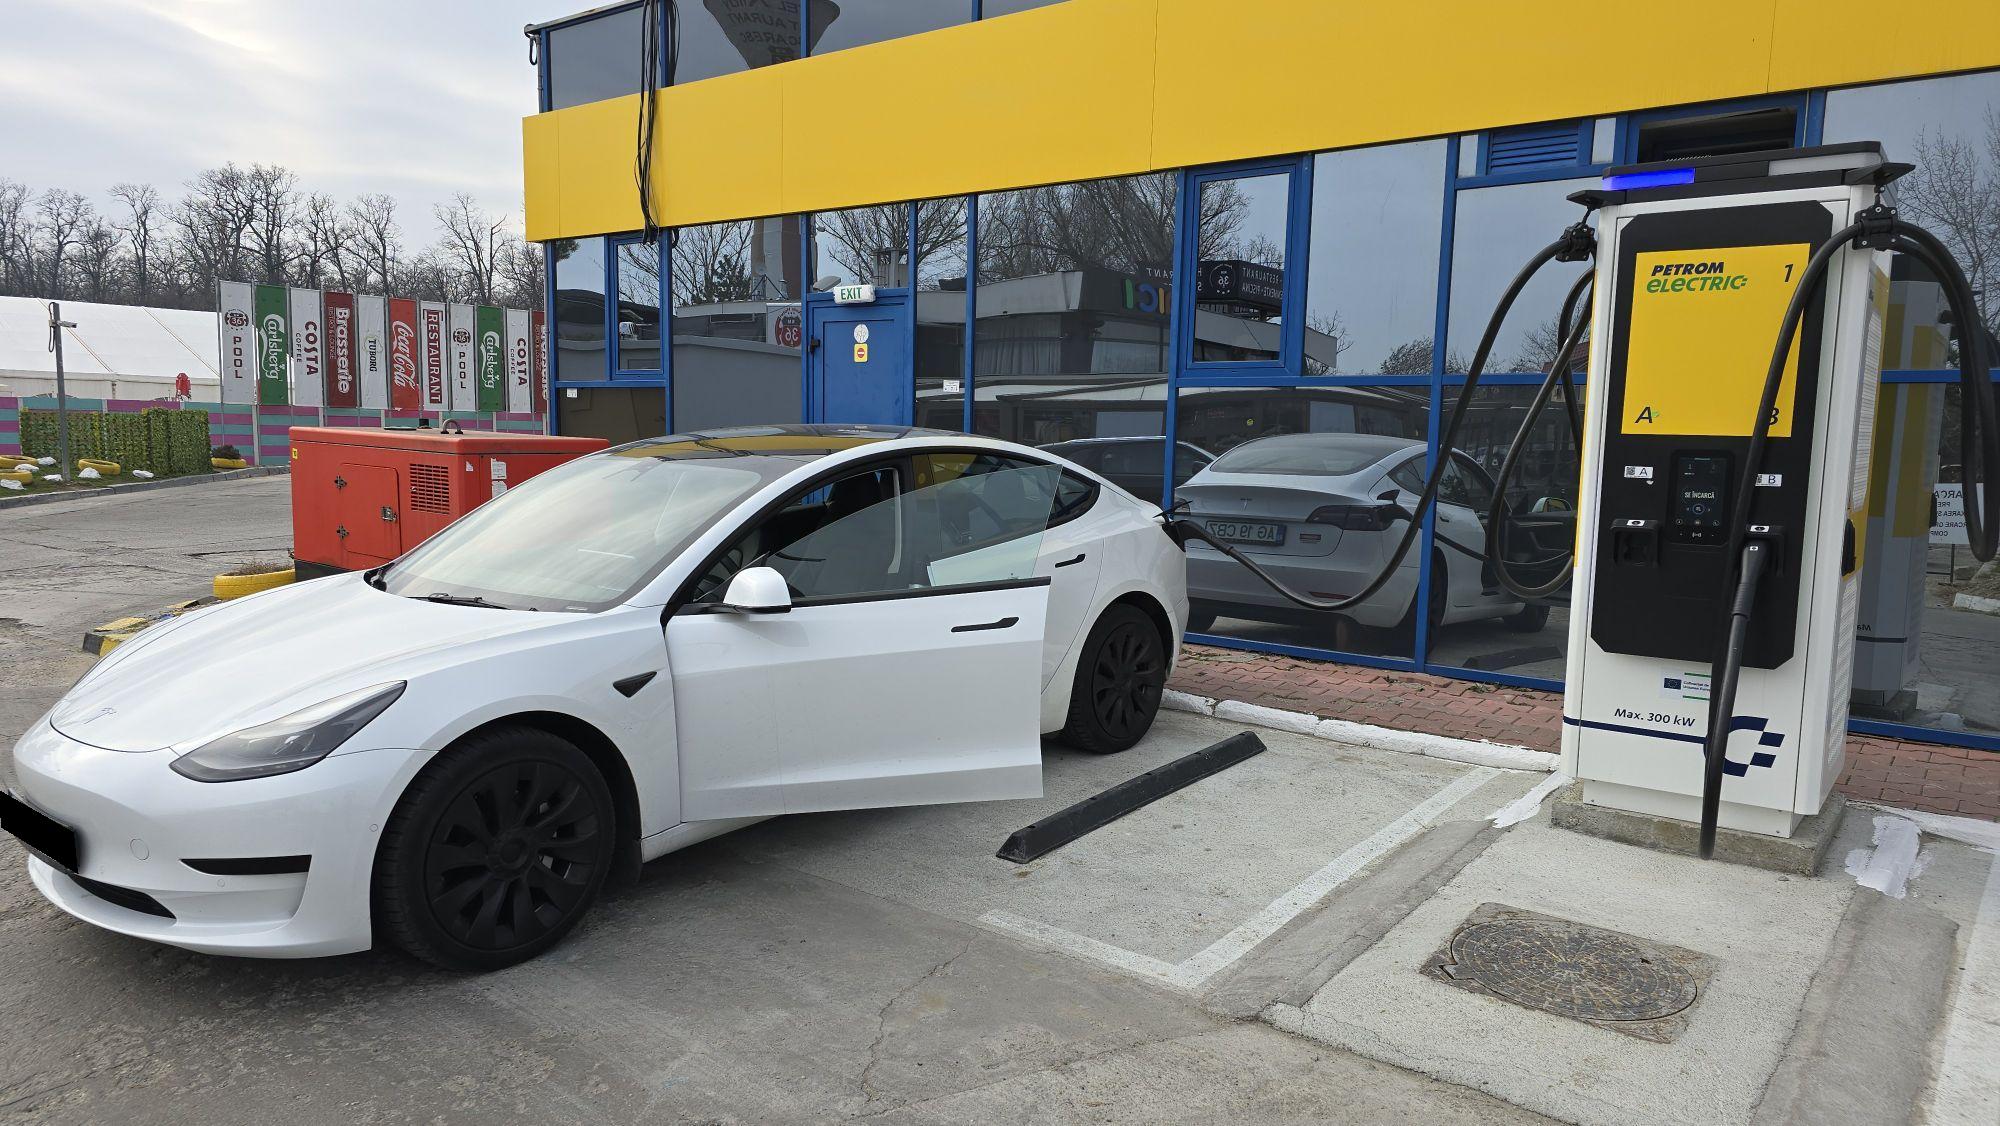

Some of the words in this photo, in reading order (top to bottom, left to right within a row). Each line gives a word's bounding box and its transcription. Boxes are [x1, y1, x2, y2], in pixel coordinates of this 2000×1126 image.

[1651, 261, 1724, 277] PETROM
[1784, 263, 1794, 283] 1
[840, 286, 862, 300] EXIT
[233, 336, 243, 379] POOL
[259, 313, 285, 380] Carlsberg
[304, 321, 319, 376] COSTA
[335, 307, 353, 394] Brasserie
[368, 339, 377, 372] TUBORG
[428, 314, 441, 402] RESTAURANT
[480, 331, 500, 389] Carlsberg
[516, 337, 527, 386] COSTA
[459, 351, 467, 389] POOL
[1634, 406, 1653, 424] A
[1639, 467, 1648, 476] A
[1768, 474, 1776, 484] B
[1614, 708, 1644, 721] Max.
[1647, 712, 1670, 724] 300
[1673, 714, 1696, 727] kW
